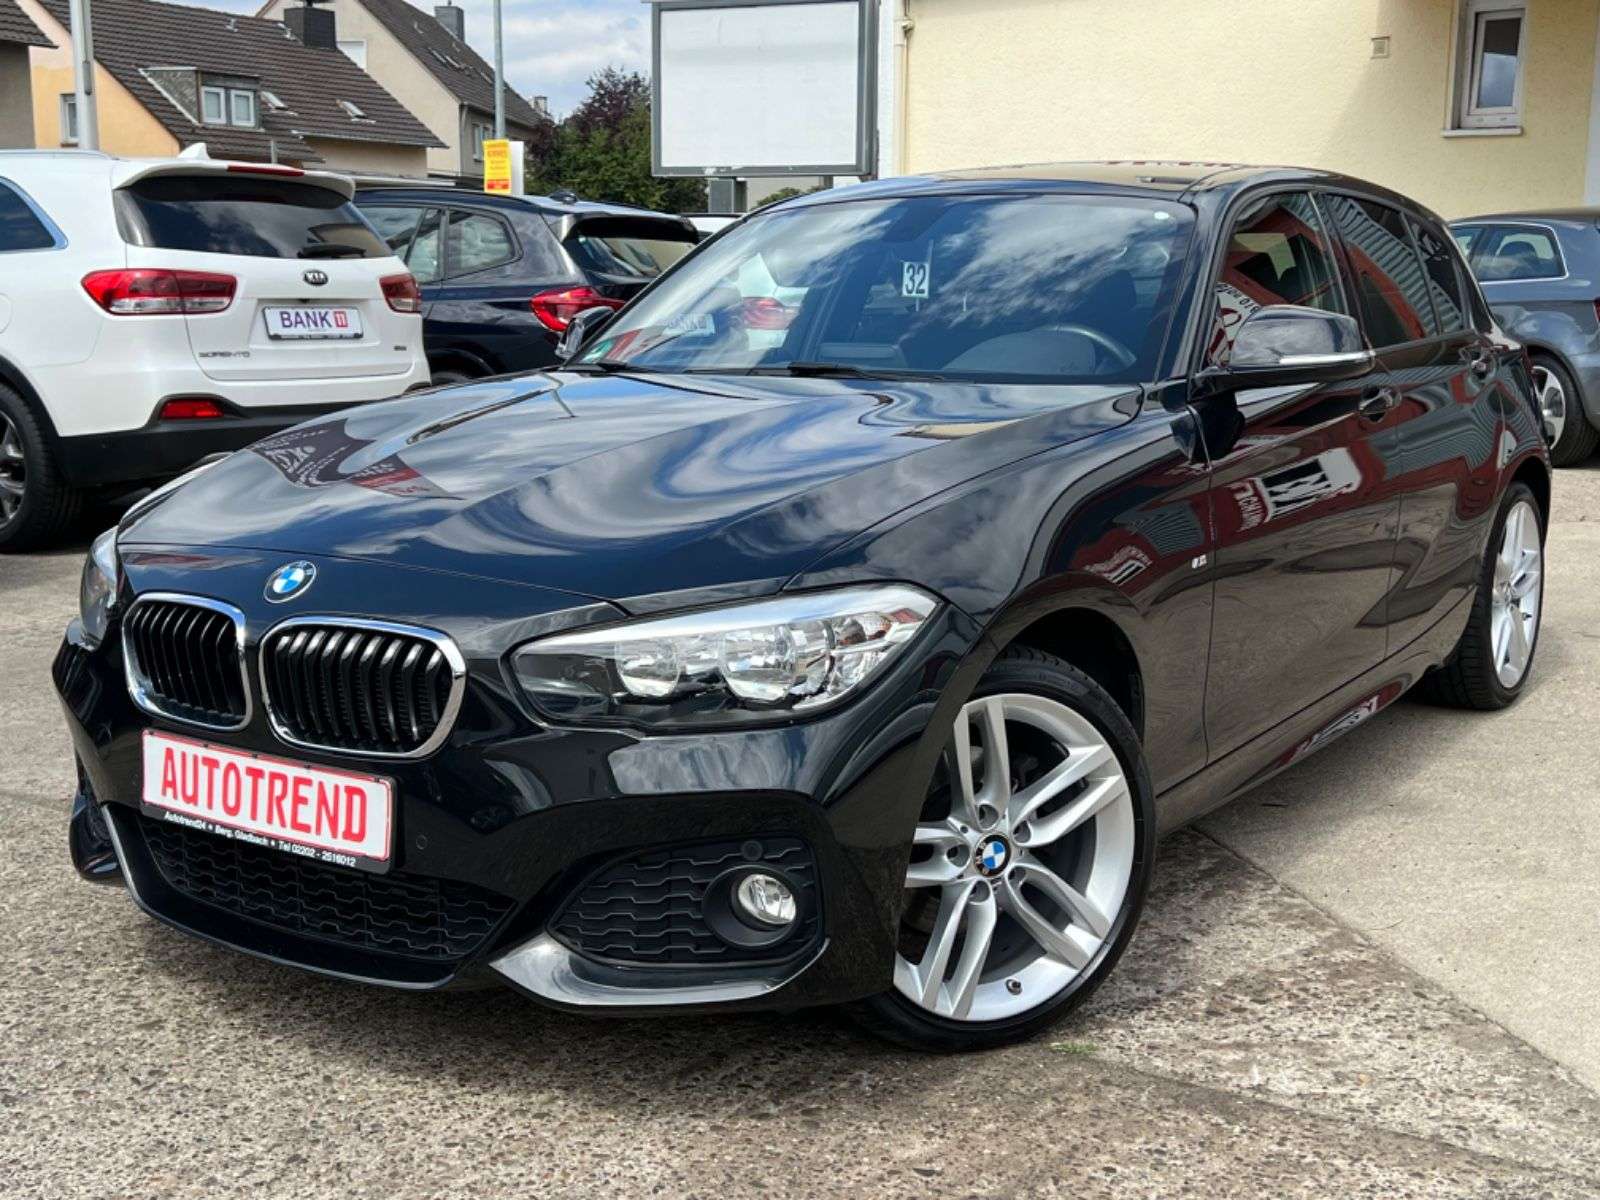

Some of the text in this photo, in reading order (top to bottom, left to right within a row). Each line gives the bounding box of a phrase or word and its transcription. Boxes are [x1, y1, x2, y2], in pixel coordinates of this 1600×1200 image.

[905, 263, 926, 295] 32
[280, 310, 332, 328] BANK
[161, 746, 368, 843] AUTOTREND
